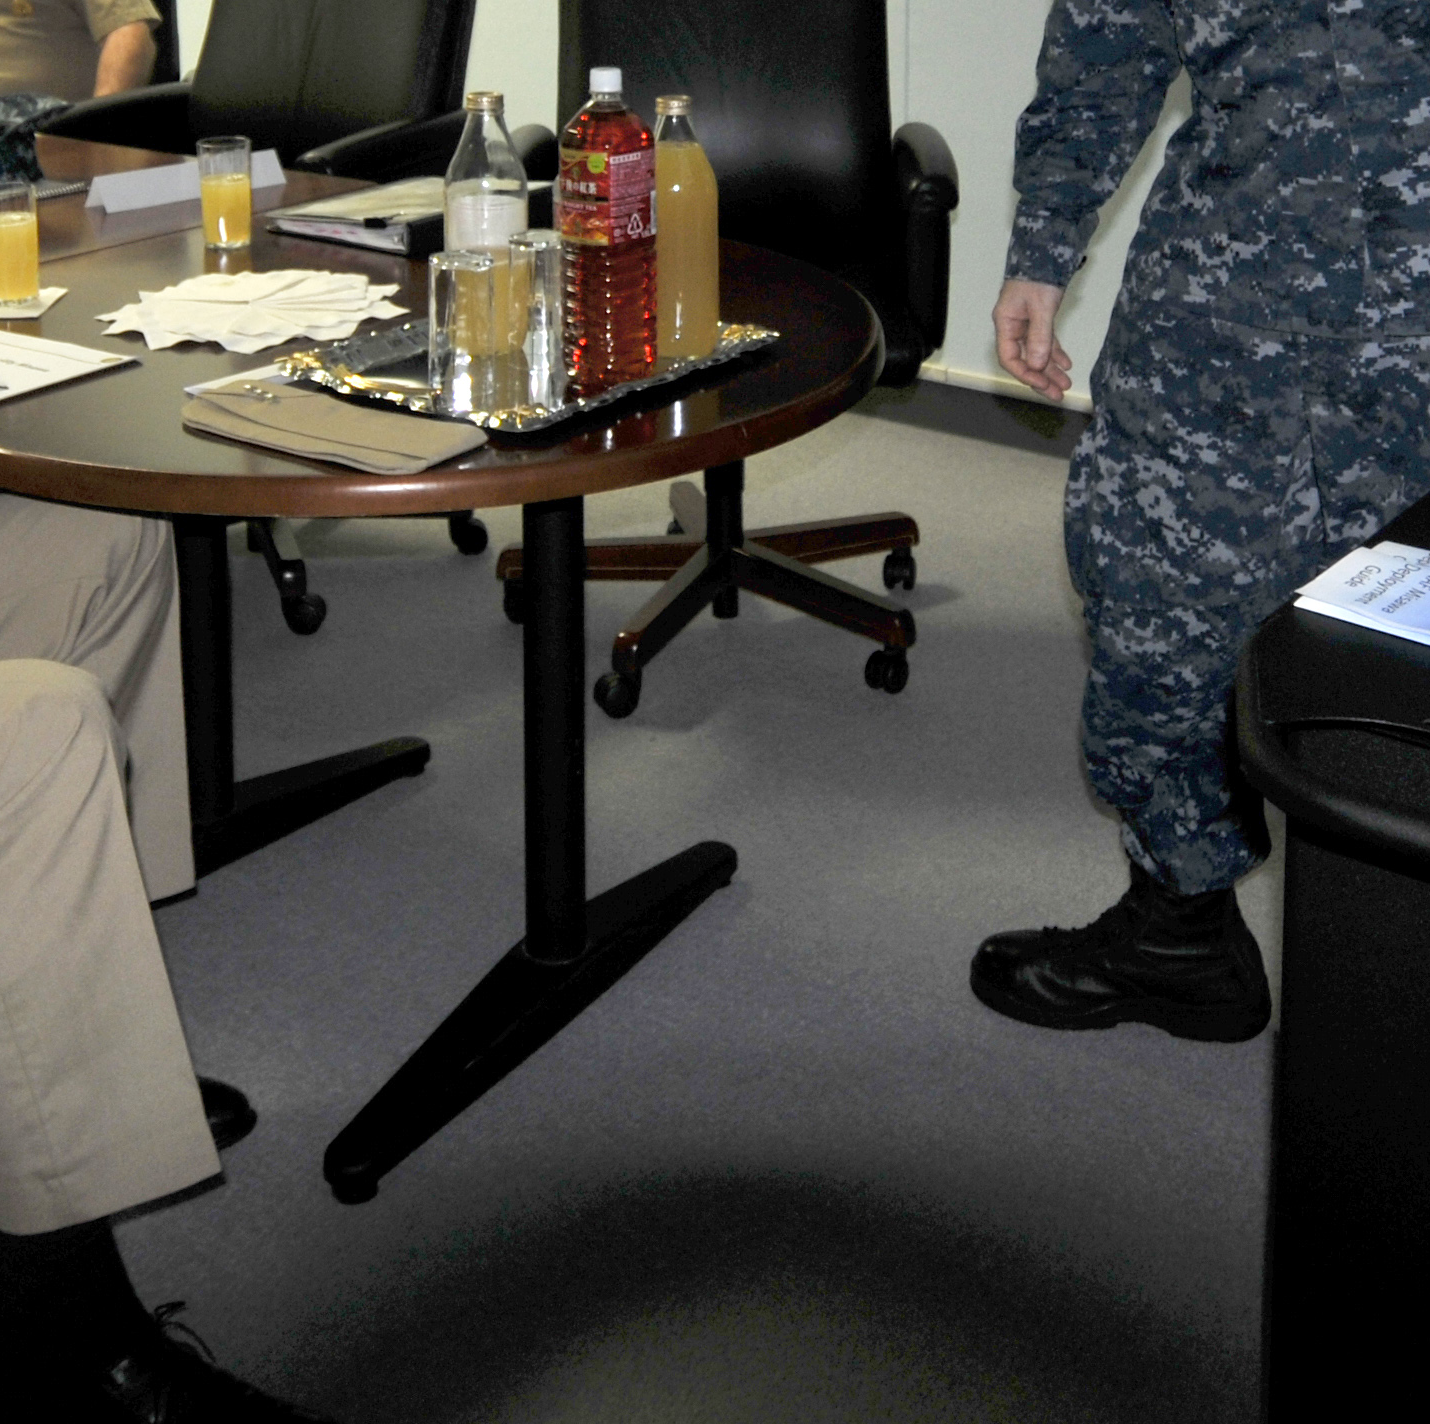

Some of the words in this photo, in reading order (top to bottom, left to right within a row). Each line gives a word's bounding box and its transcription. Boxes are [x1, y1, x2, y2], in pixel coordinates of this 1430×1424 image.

[1344, 565, 1381, 587] Guide
[1355, 563, 1422, 605] Deployment
[1381, 587, 1426, 613] Misawa
